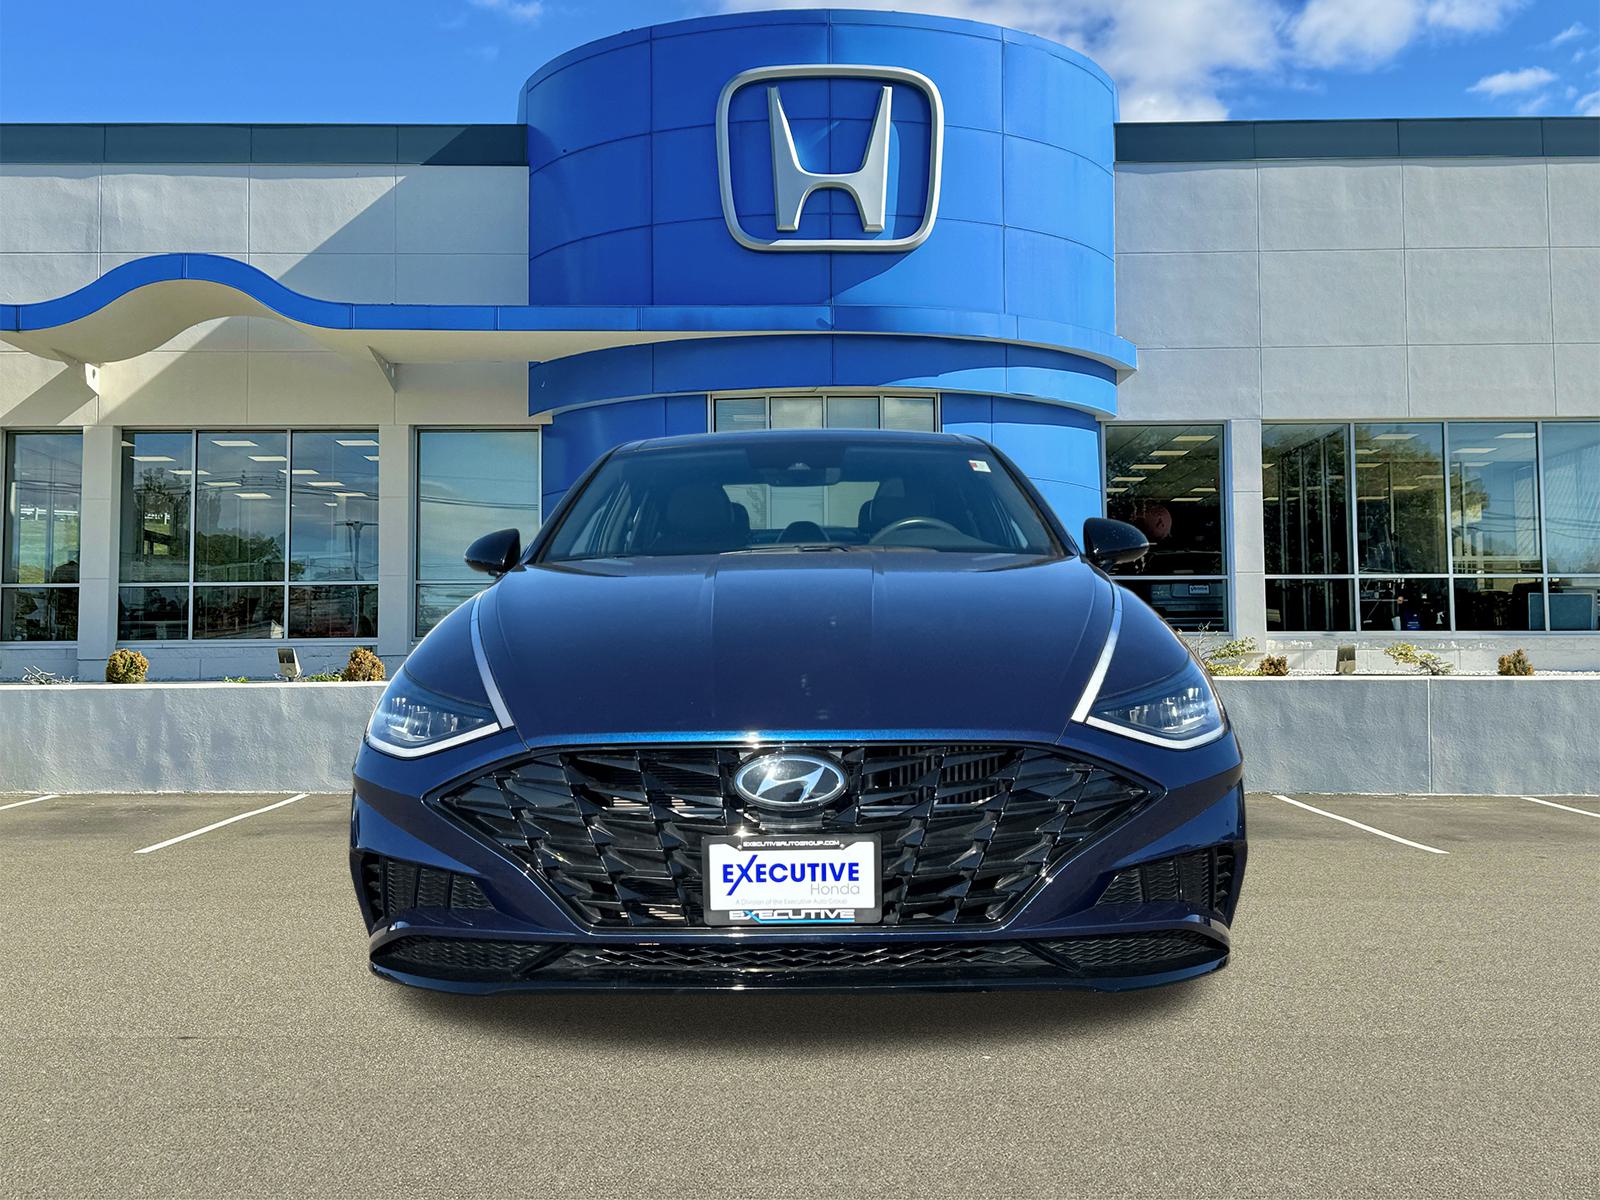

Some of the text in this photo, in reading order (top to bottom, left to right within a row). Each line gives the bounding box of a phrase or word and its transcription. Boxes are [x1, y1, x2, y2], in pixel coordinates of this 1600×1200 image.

[722, 855, 860, 896] EXECUTIVE
[810, 883, 860, 896] Honda
[729, 909, 855, 924] EXECUTIVE
